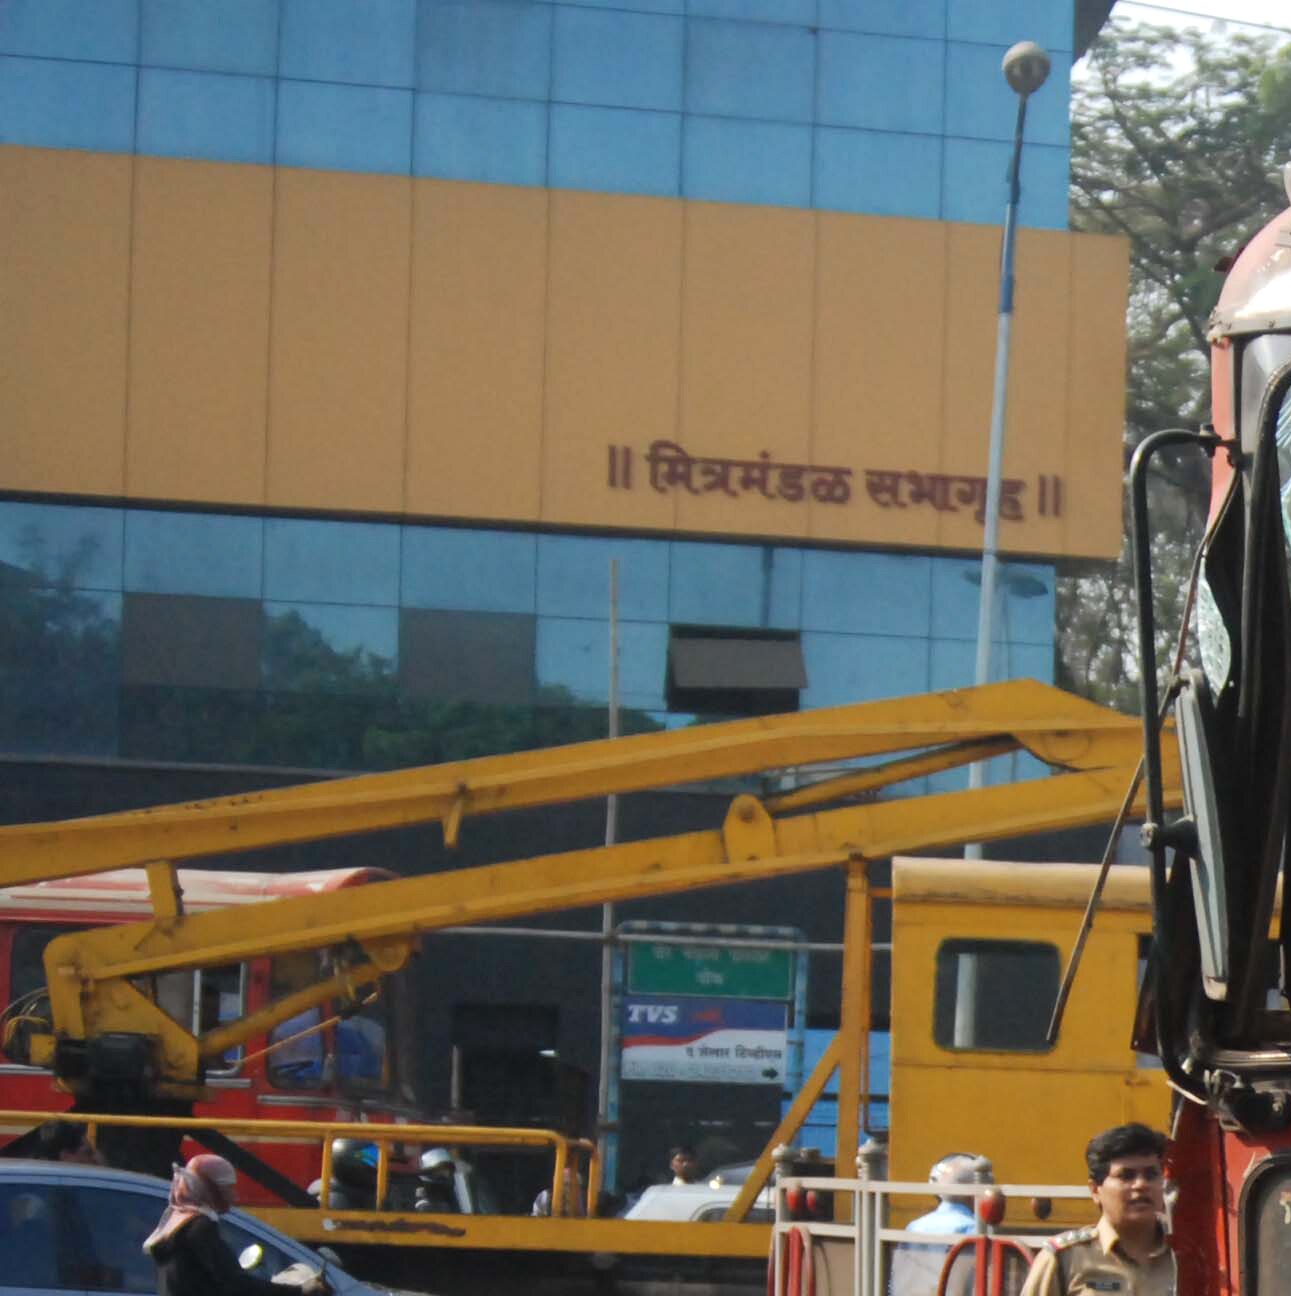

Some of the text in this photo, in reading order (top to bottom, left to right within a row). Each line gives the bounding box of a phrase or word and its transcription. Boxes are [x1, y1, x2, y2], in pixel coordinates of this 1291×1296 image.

[644, 440, 851, 504] मित्रमंडळ
[864, 467, 1024, 526] सभागृह
[627, 1004, 679, 1024] TVS
